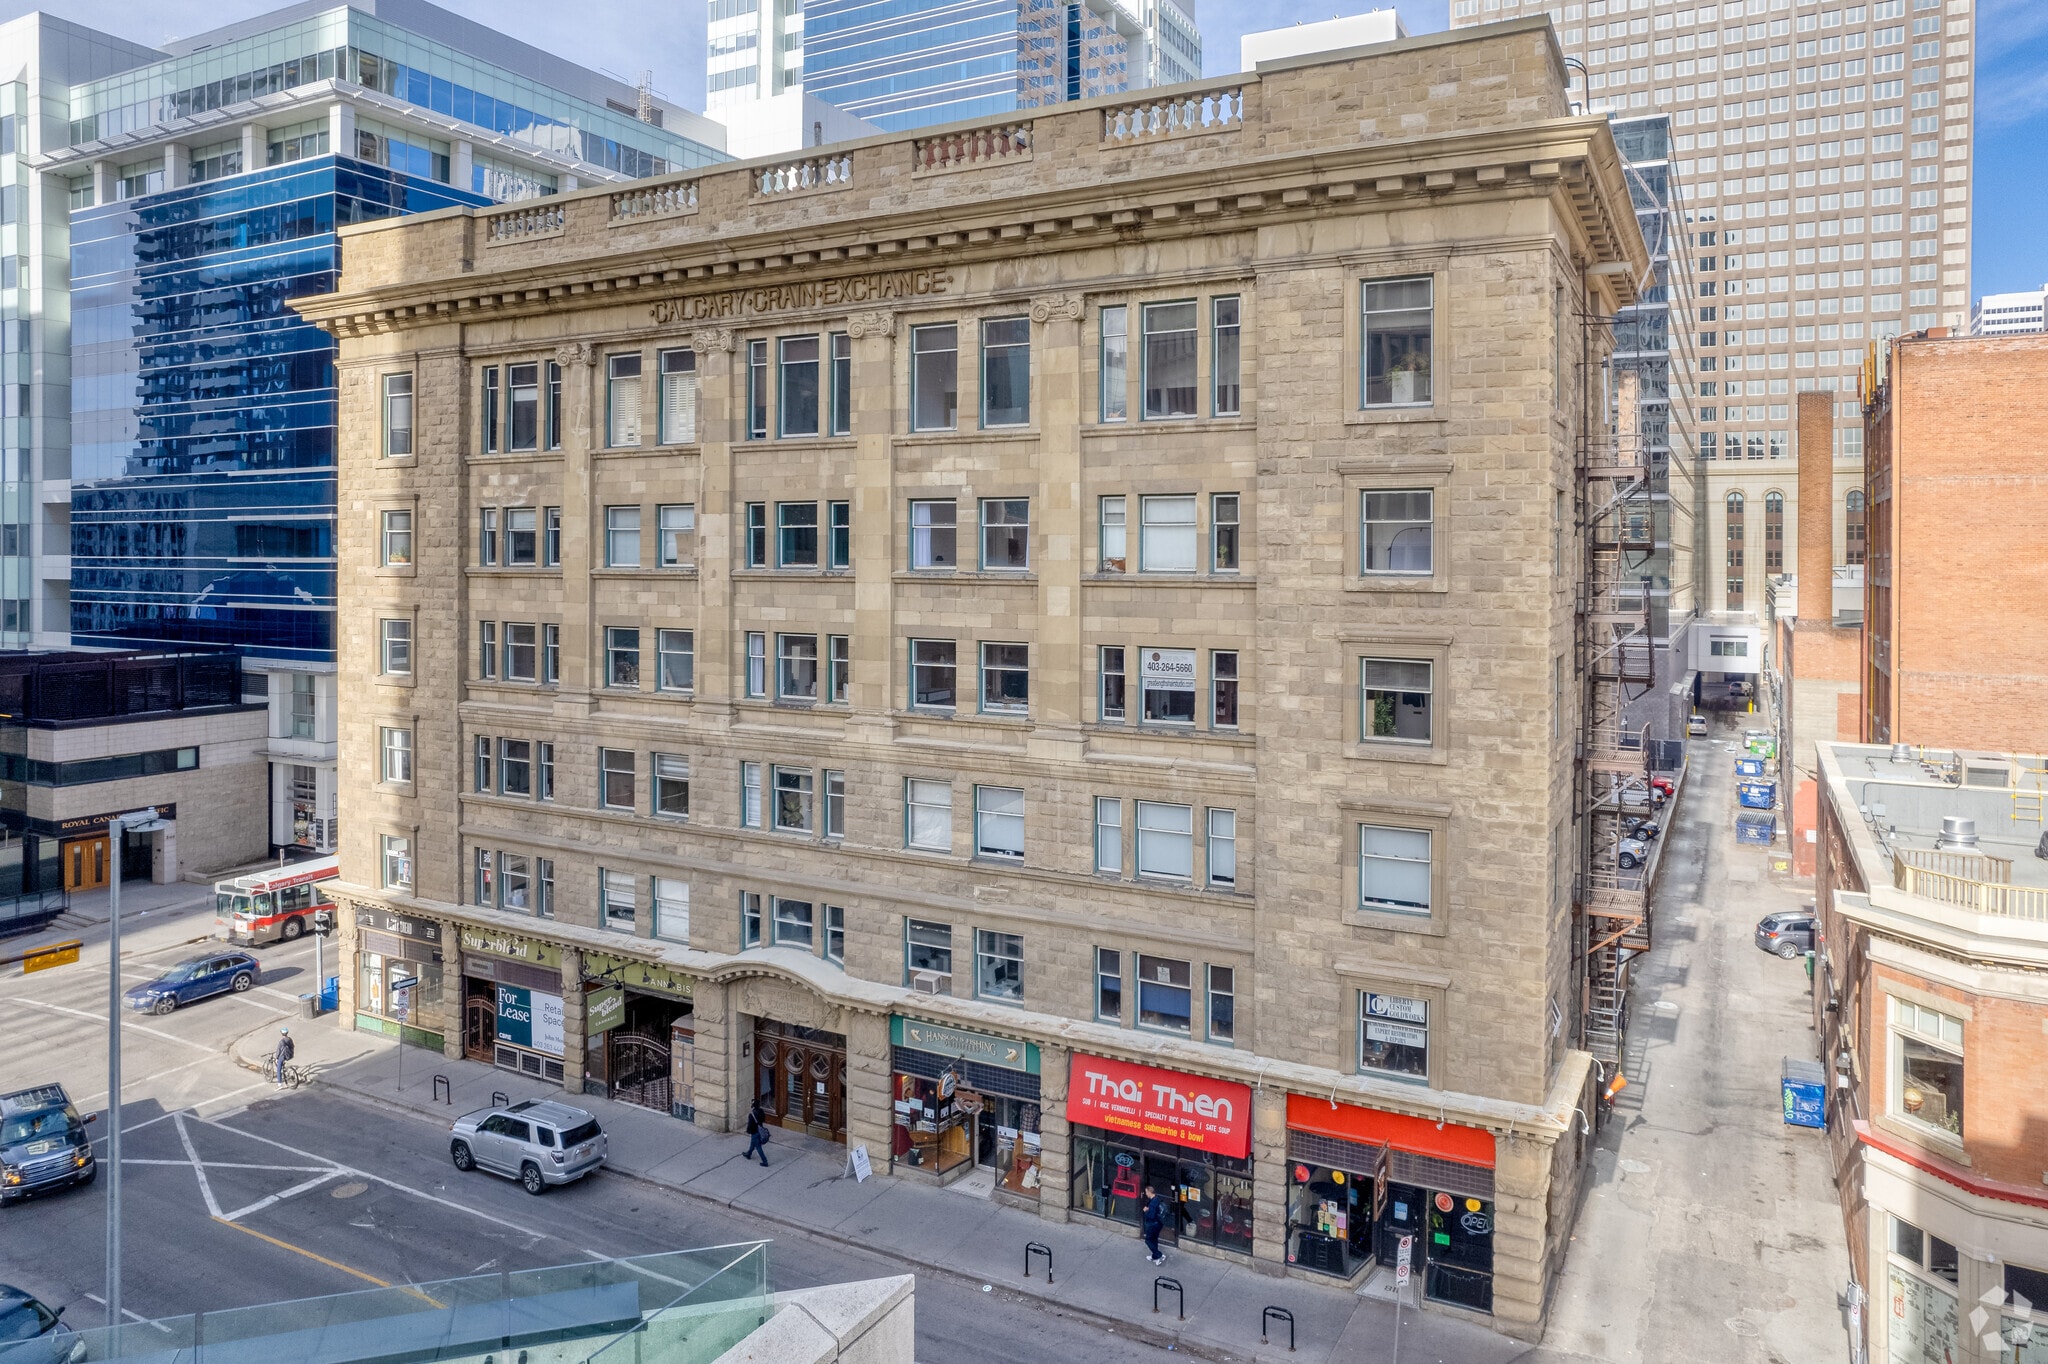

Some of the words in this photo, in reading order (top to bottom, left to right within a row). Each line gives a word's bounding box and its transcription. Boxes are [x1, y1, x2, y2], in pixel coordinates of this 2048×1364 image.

[654, 291, 744, 323] CALGARY
[752, 283, 816, 312] GRAIN
[823, 268, 946, 304] EXCHANGE
[61, 820, 90, 829] ROYAL
[269, 880, 291, 891] Calgary
[293, 874, 313, 884] Transit
[645, 978, 691, 993] ANNBIS
[498, 987, 517, 1005] For
[499, 1002, 530, 1023] Lease
[545, 1003, 564, 1016] Retai
[965, 1037, 997, 1056] FISHING
[1085, 1071, 1143, 1102] Thai
[1152, 1084, 1233, 1121] Thien
[1100, 1102, 1109, 1110] RICE
[1112, 1104, 1136, 1115] VERMICELLI
[1145, 1111, 1167, 1121] SPECIALTY
[1169, 1115, 1179, 1124] RICE
[1180, 1118, 1196, 1127] DISHES
[1206, 1123, 1217, 1132] SATE
[1218, 1126, 1230, 1134] SOUP
[1105, 1115, 1141, 1129] vietnamese
[1144, 1121, 1178, 1137] submarine
[1180, 1130, 1186, 1138] &
[1188, 1131, 1204, 1143] bowl
